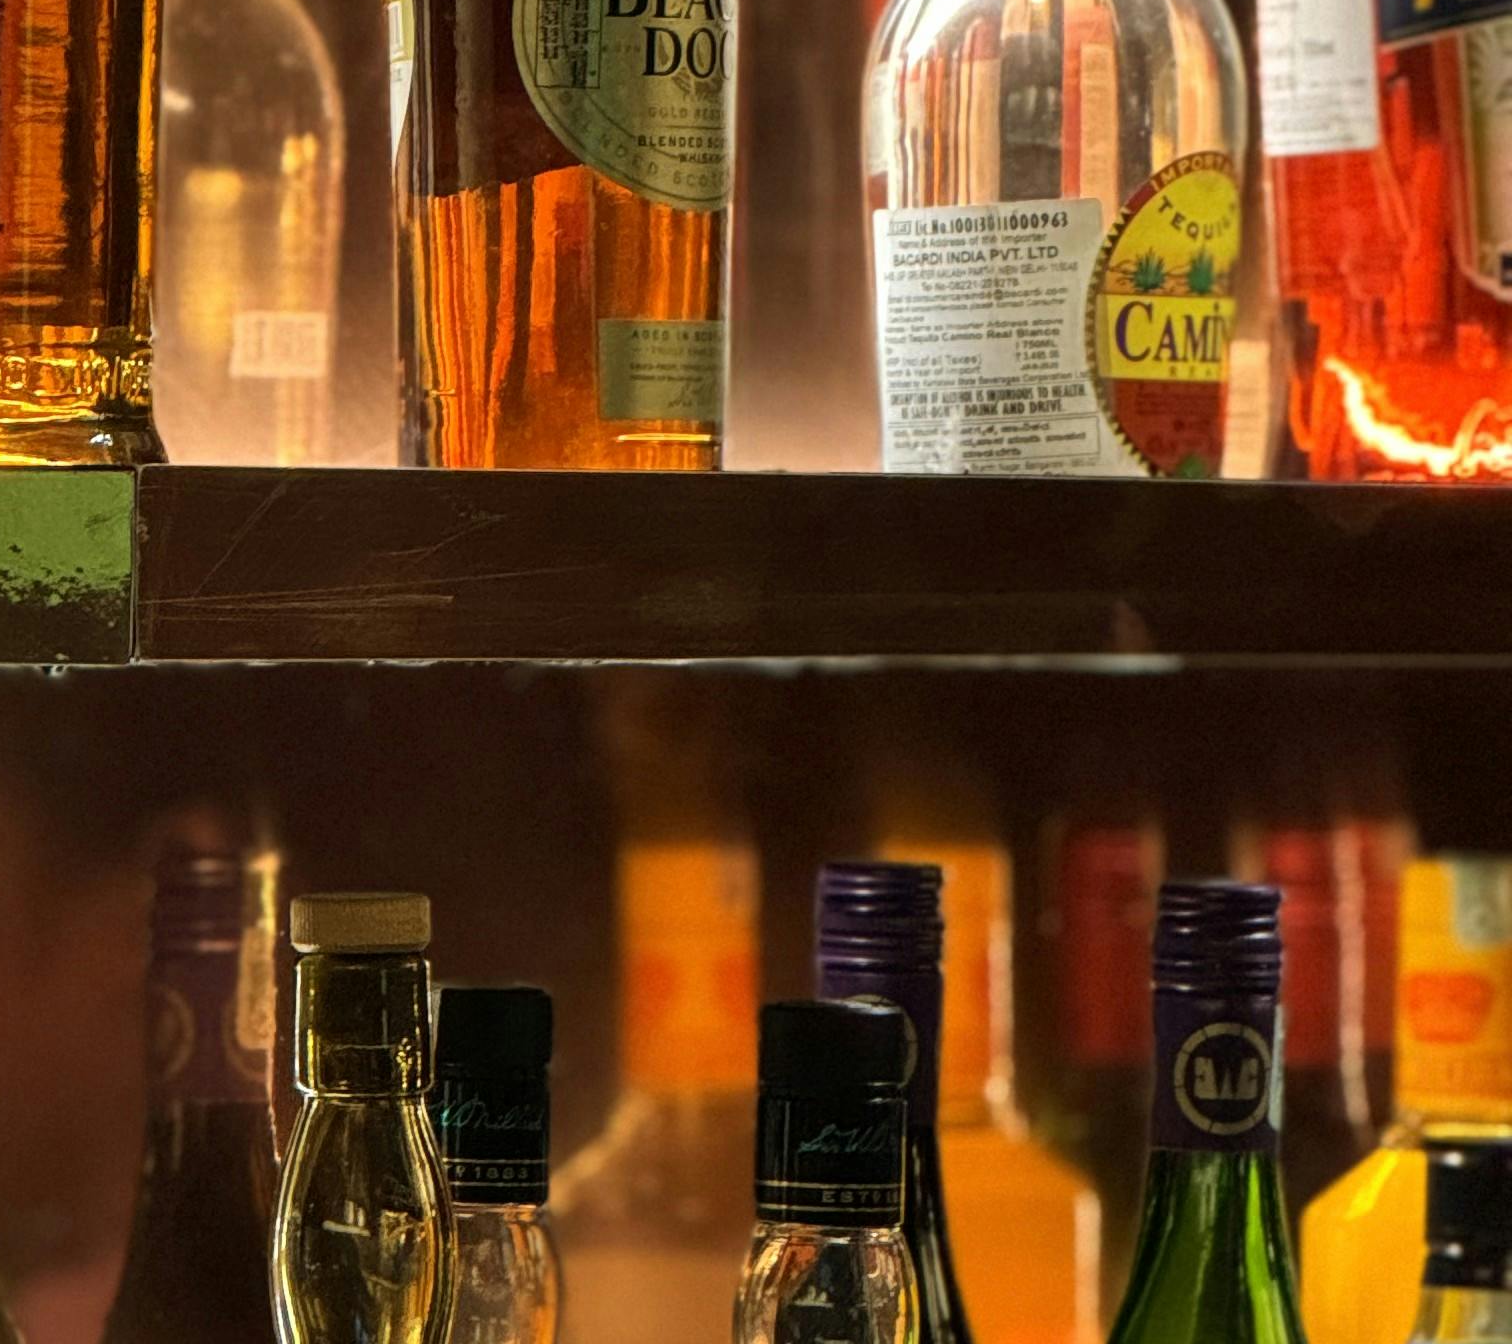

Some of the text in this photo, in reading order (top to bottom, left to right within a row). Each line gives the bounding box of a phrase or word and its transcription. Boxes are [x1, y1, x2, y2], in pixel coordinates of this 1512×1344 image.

[637, 135, 703, 148] BLENDED
[929, 236, 966, 248] Address
[1000, 233, 1049, 246] Importer
[892, 245, 1060, 267] BACARDI INDIA PVT. LTD
[1031, 318, 1064, 326] above
[941, 331, 983, 342] Camino
[986, 330, 1013, 340] Real
[1016, 327, 1061, 339] Blanco
[1037, 387, 1049, 399] TO
[964, 402, 1025, 418] DRINK AND
